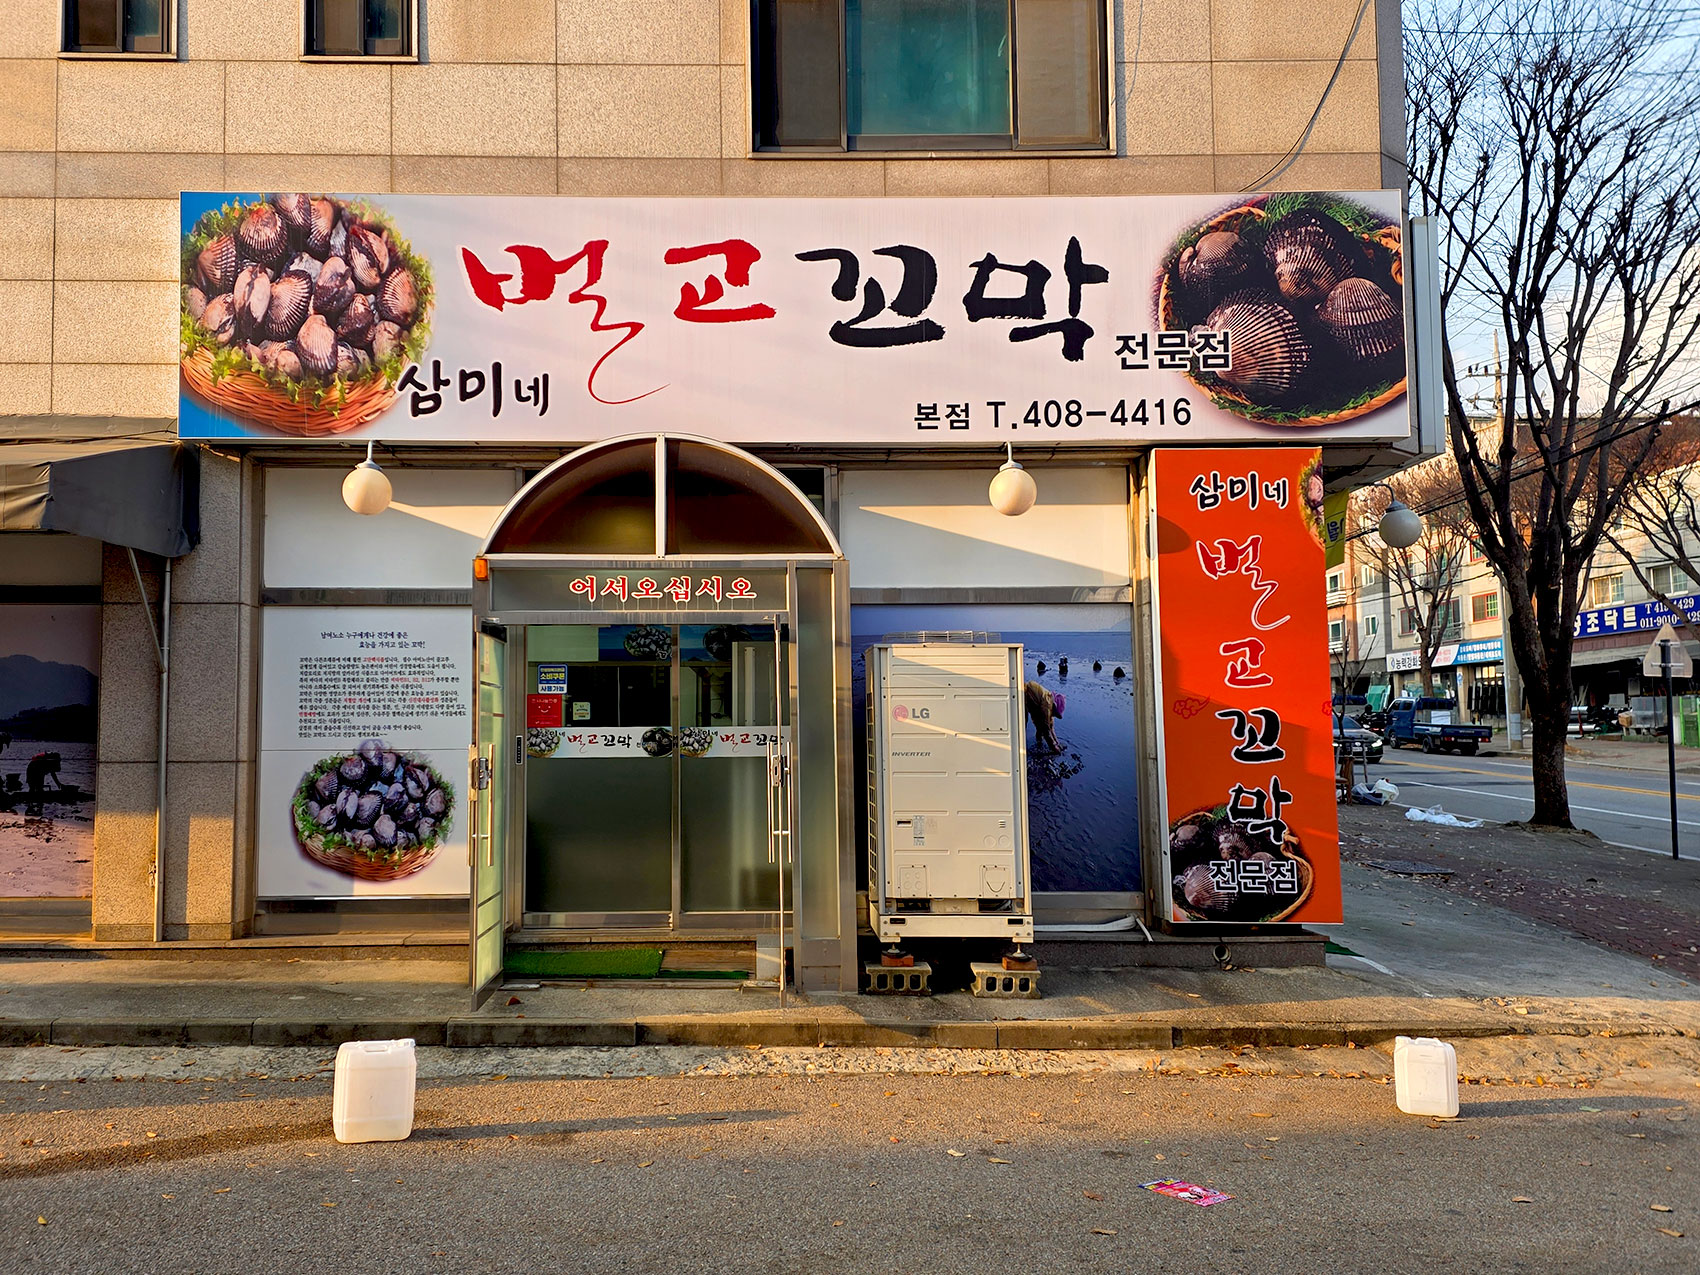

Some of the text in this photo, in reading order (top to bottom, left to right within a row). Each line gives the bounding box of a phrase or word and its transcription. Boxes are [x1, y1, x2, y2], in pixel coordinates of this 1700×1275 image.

[1113, 331, 1233, 371] 전문점
[397, 361, 550, 417] 삼미네
[914, 398, 1193, 430] 본점 T.408-4416
[1190, 471, 1288, 511] 삼미네
[569, 575, 757, 602] 어서오십시오
[912, 708, 930, 719] LG
[1209, 860, 1298, 894] 전문점
